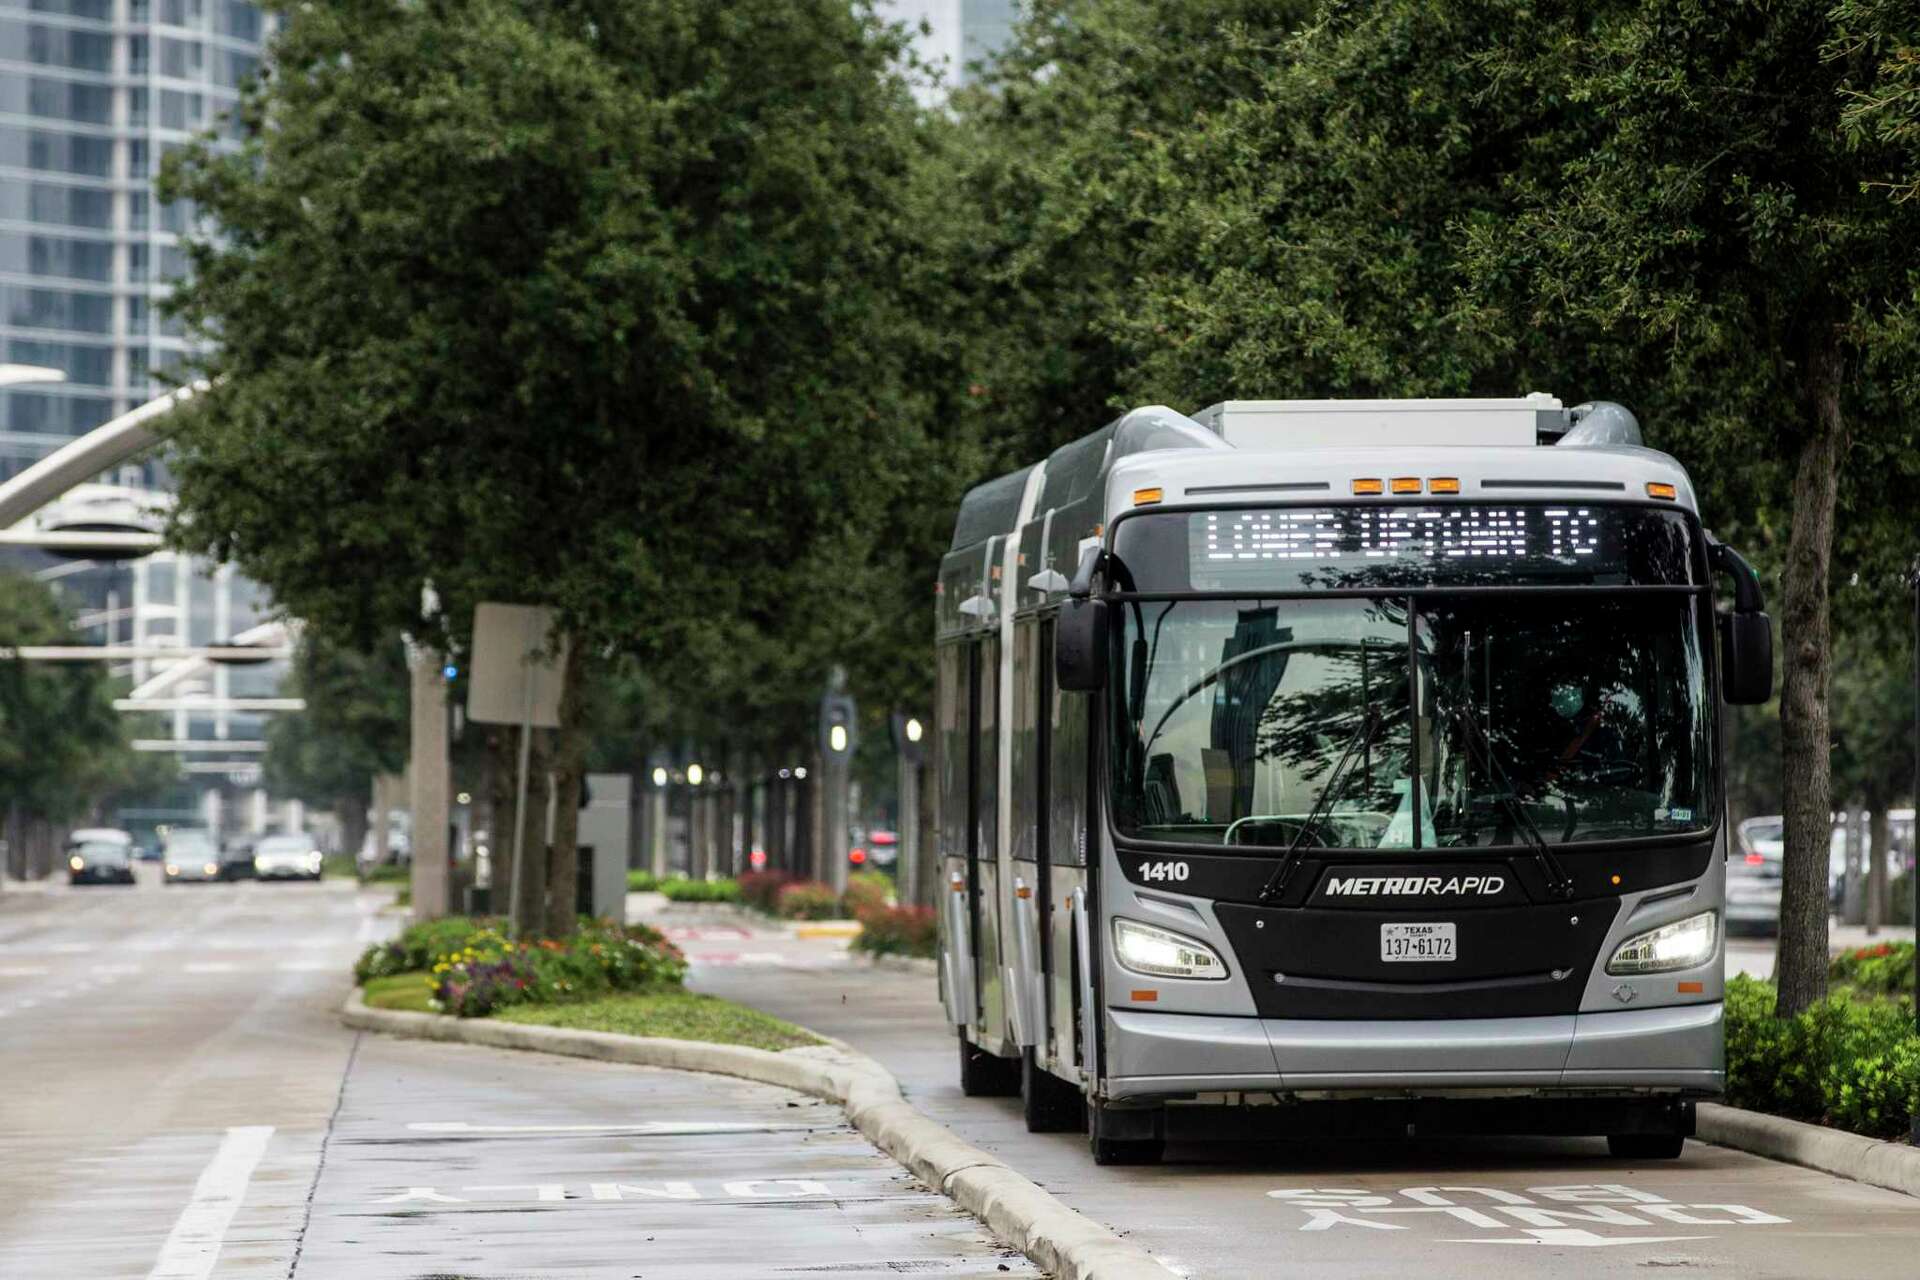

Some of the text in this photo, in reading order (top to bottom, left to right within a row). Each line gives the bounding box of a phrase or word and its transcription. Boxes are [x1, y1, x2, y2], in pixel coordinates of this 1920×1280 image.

[1544, 509, 1598, 554] TC
[1138, 861, 1190, 881] 1410
[1404, 926, 1433, 935] TEXAS
[376, 1178, 831, 1202] ONLY
[1265, 1184, 1672, 1206] BUS
[1298, 1203, 1793, 1231] ONLY
